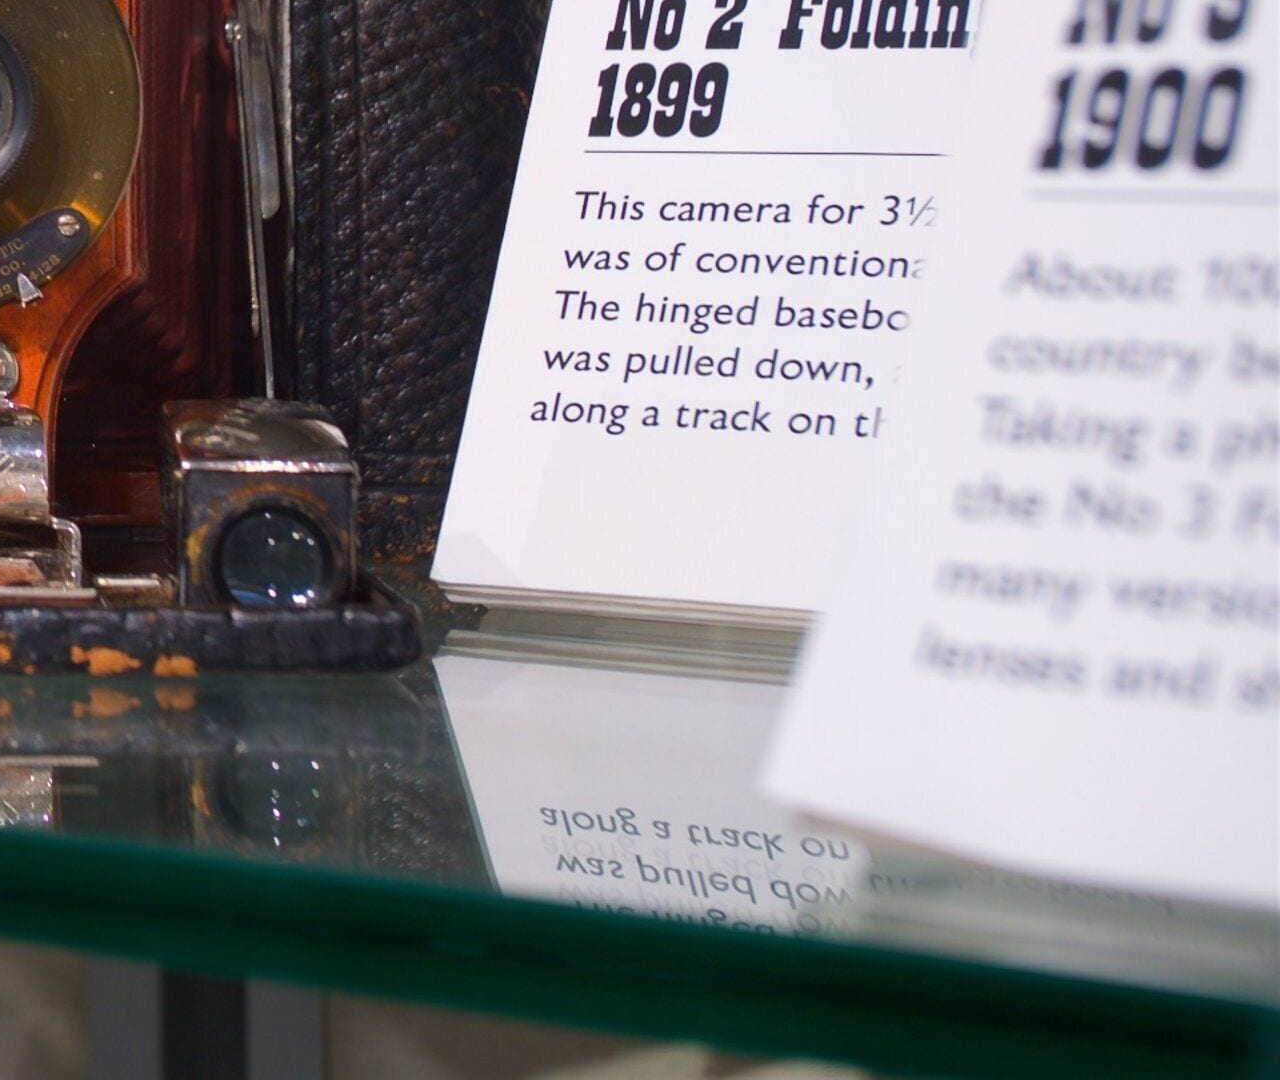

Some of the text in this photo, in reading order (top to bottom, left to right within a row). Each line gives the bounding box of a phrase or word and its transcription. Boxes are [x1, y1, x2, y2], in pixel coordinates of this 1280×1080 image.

[588, 61, 729, 138] 1899
[1038, 67, 1246, 170] 1900
[575, 191, 645, 221] This
[659, 197, 791, 224] camera
[807, 194, 864, 225] for
[0, 260, 27, 277] CO.
[564, 248, 630, 271] was
[644, 242, 686, 272] of
[555, 290, 620, 321] The
[635, 292, 759, 334] hinged
[544, 348, 610, 372] was
[623, 345, 740, 383] pulled
[755, 348, 875, 390] down,
[530, 392, 629, 435] along
[641, 405, 660, 428] a
[676, 401, 771, 432] track
[788, 411, 836, 436] on
